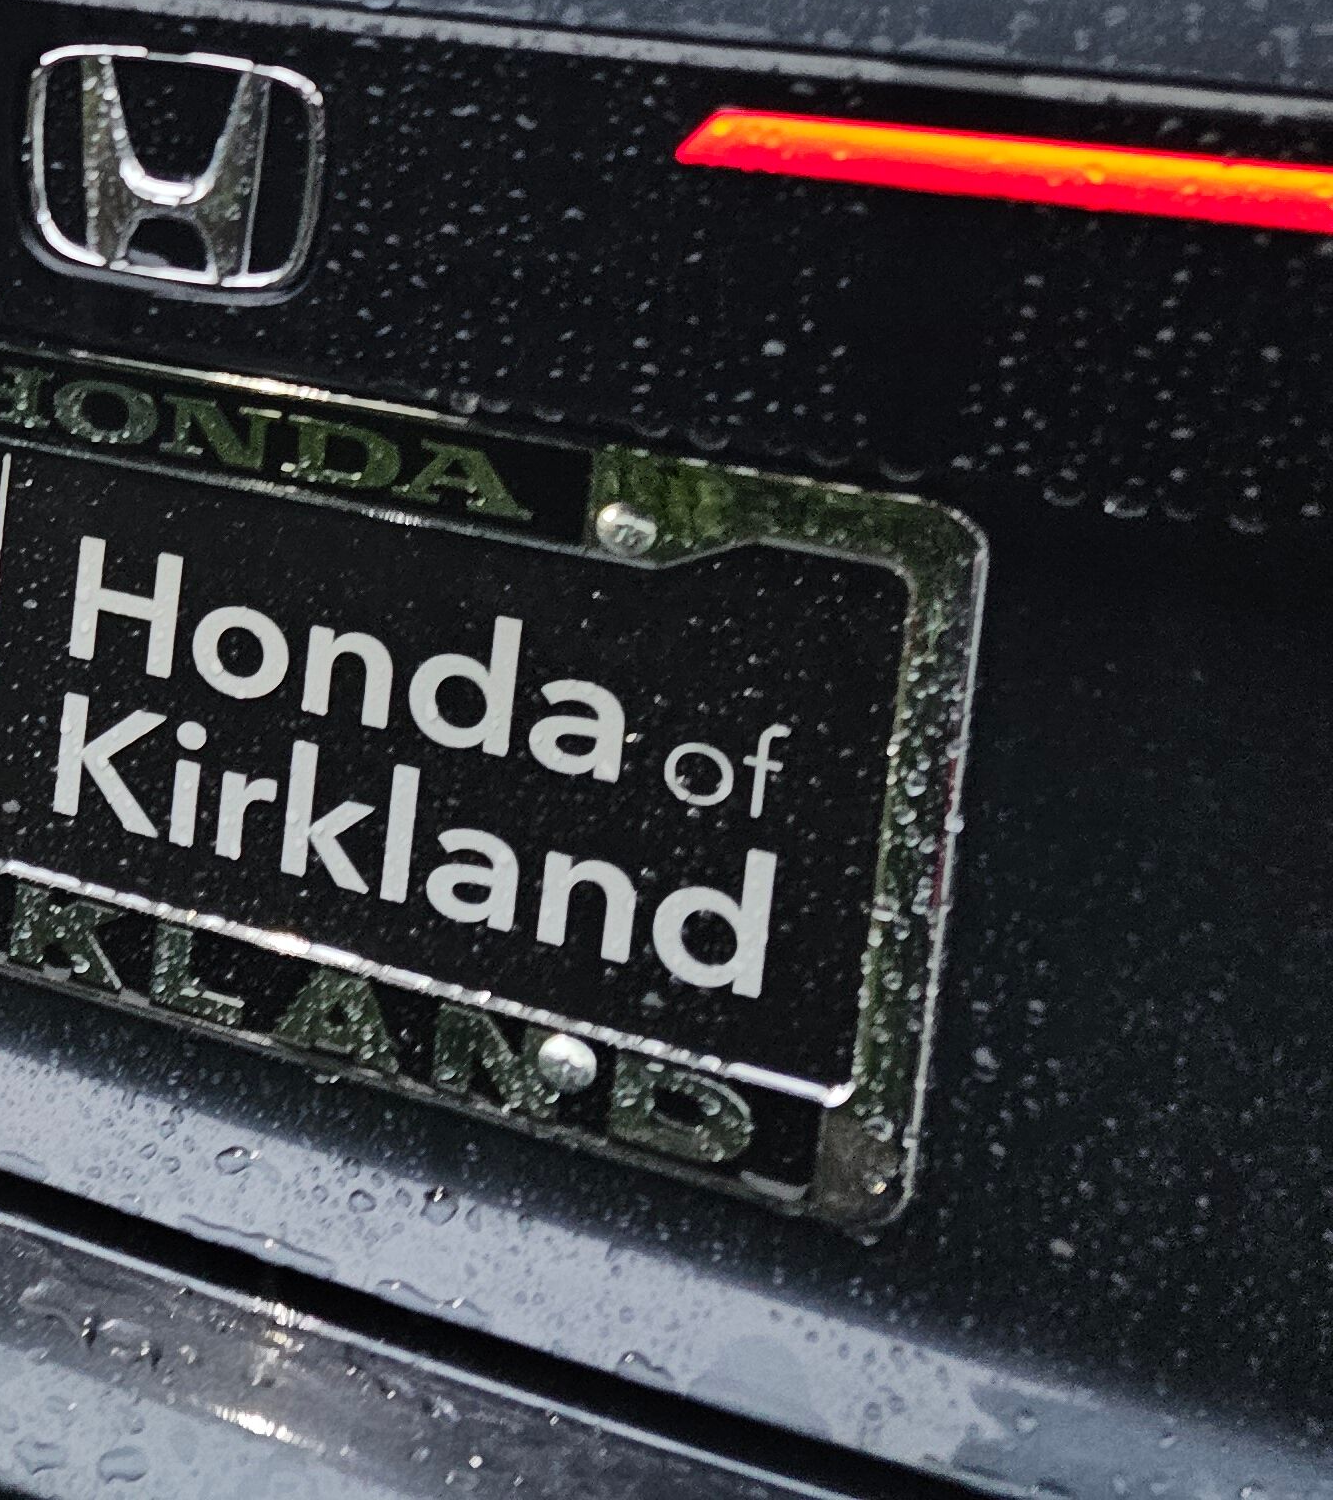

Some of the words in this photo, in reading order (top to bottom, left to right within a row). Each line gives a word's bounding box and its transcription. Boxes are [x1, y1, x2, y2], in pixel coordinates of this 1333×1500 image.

[68, 535, 628, 784] Honda
[663, 722, 792, 820] of
[52, 691, 778, 1000] Kirkland
